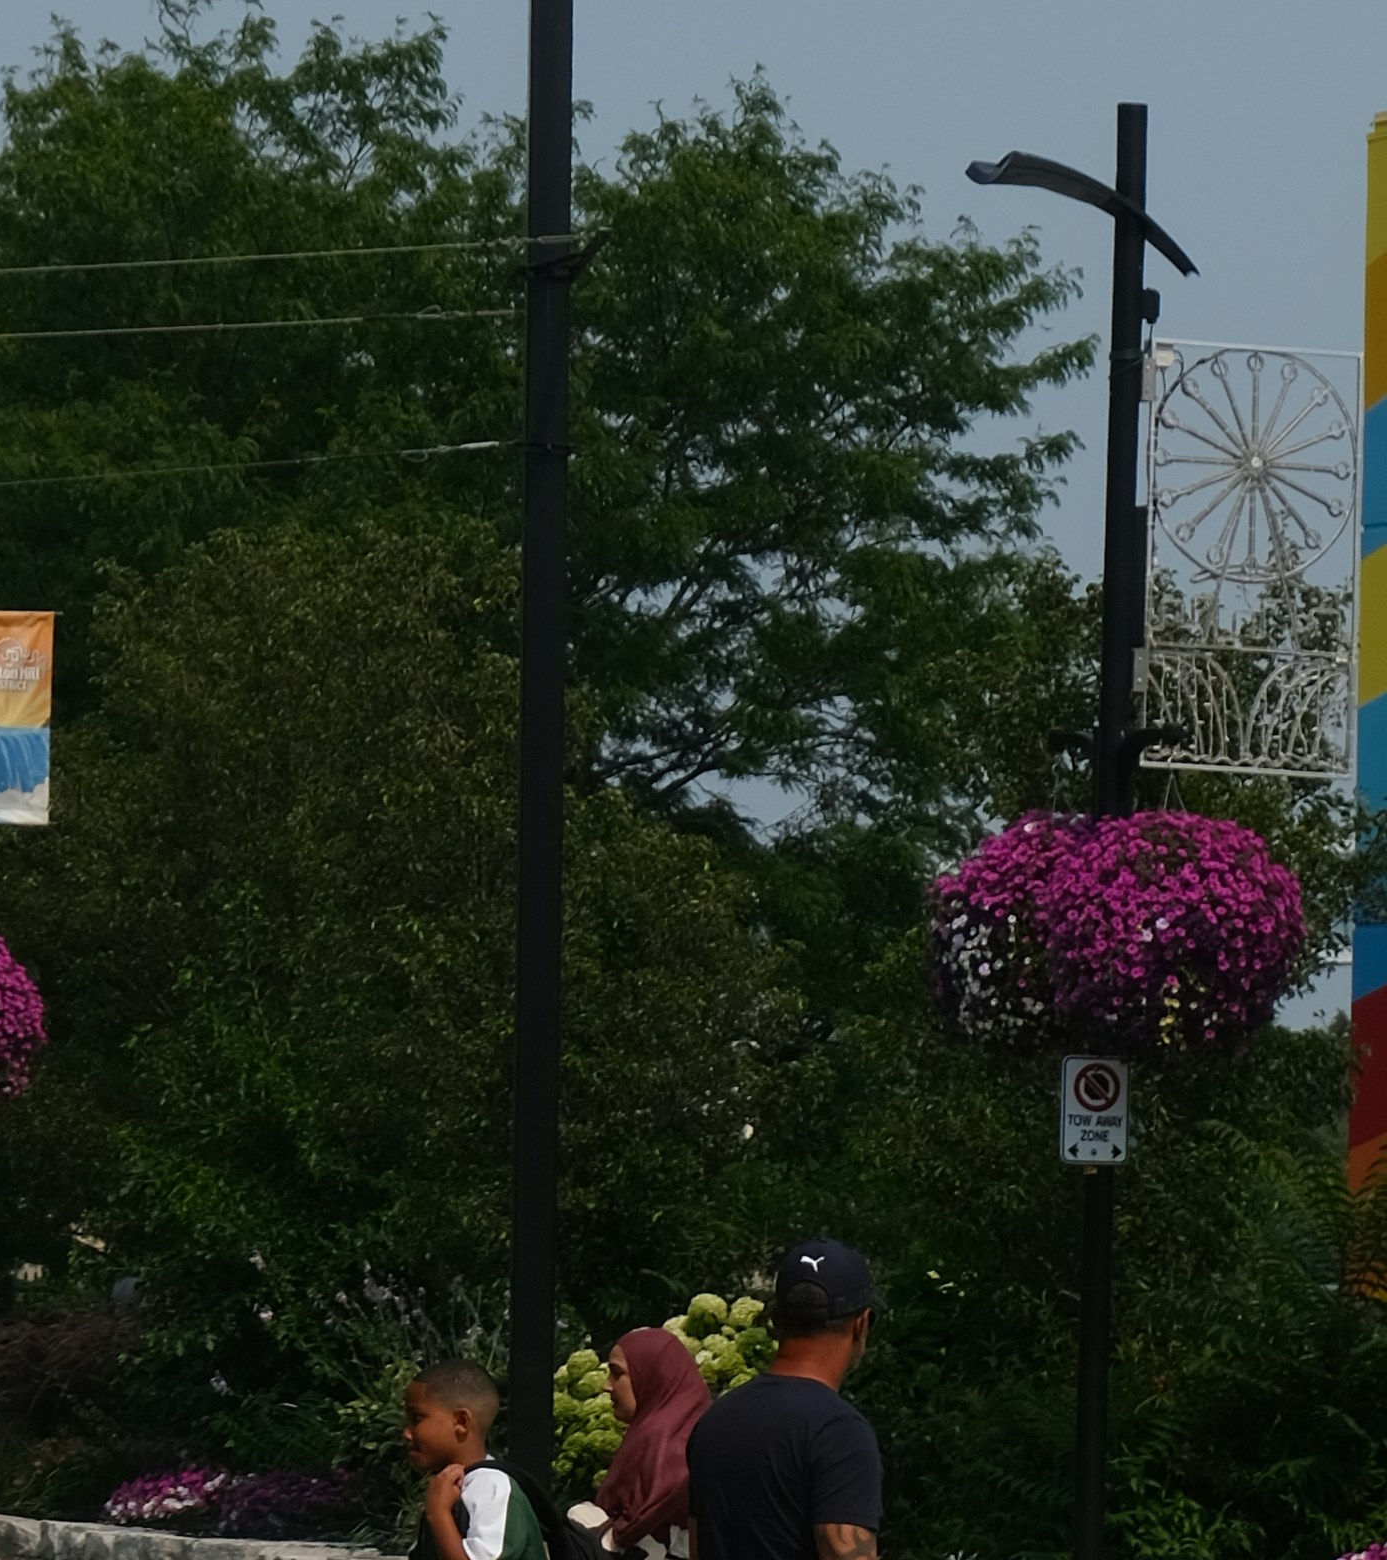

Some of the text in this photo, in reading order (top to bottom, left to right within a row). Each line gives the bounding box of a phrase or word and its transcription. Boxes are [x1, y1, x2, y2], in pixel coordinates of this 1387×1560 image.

[1068, 1114, 1123, 1128] TOW AWAY
[1080, 1129, 1110, 1142] ZONE
